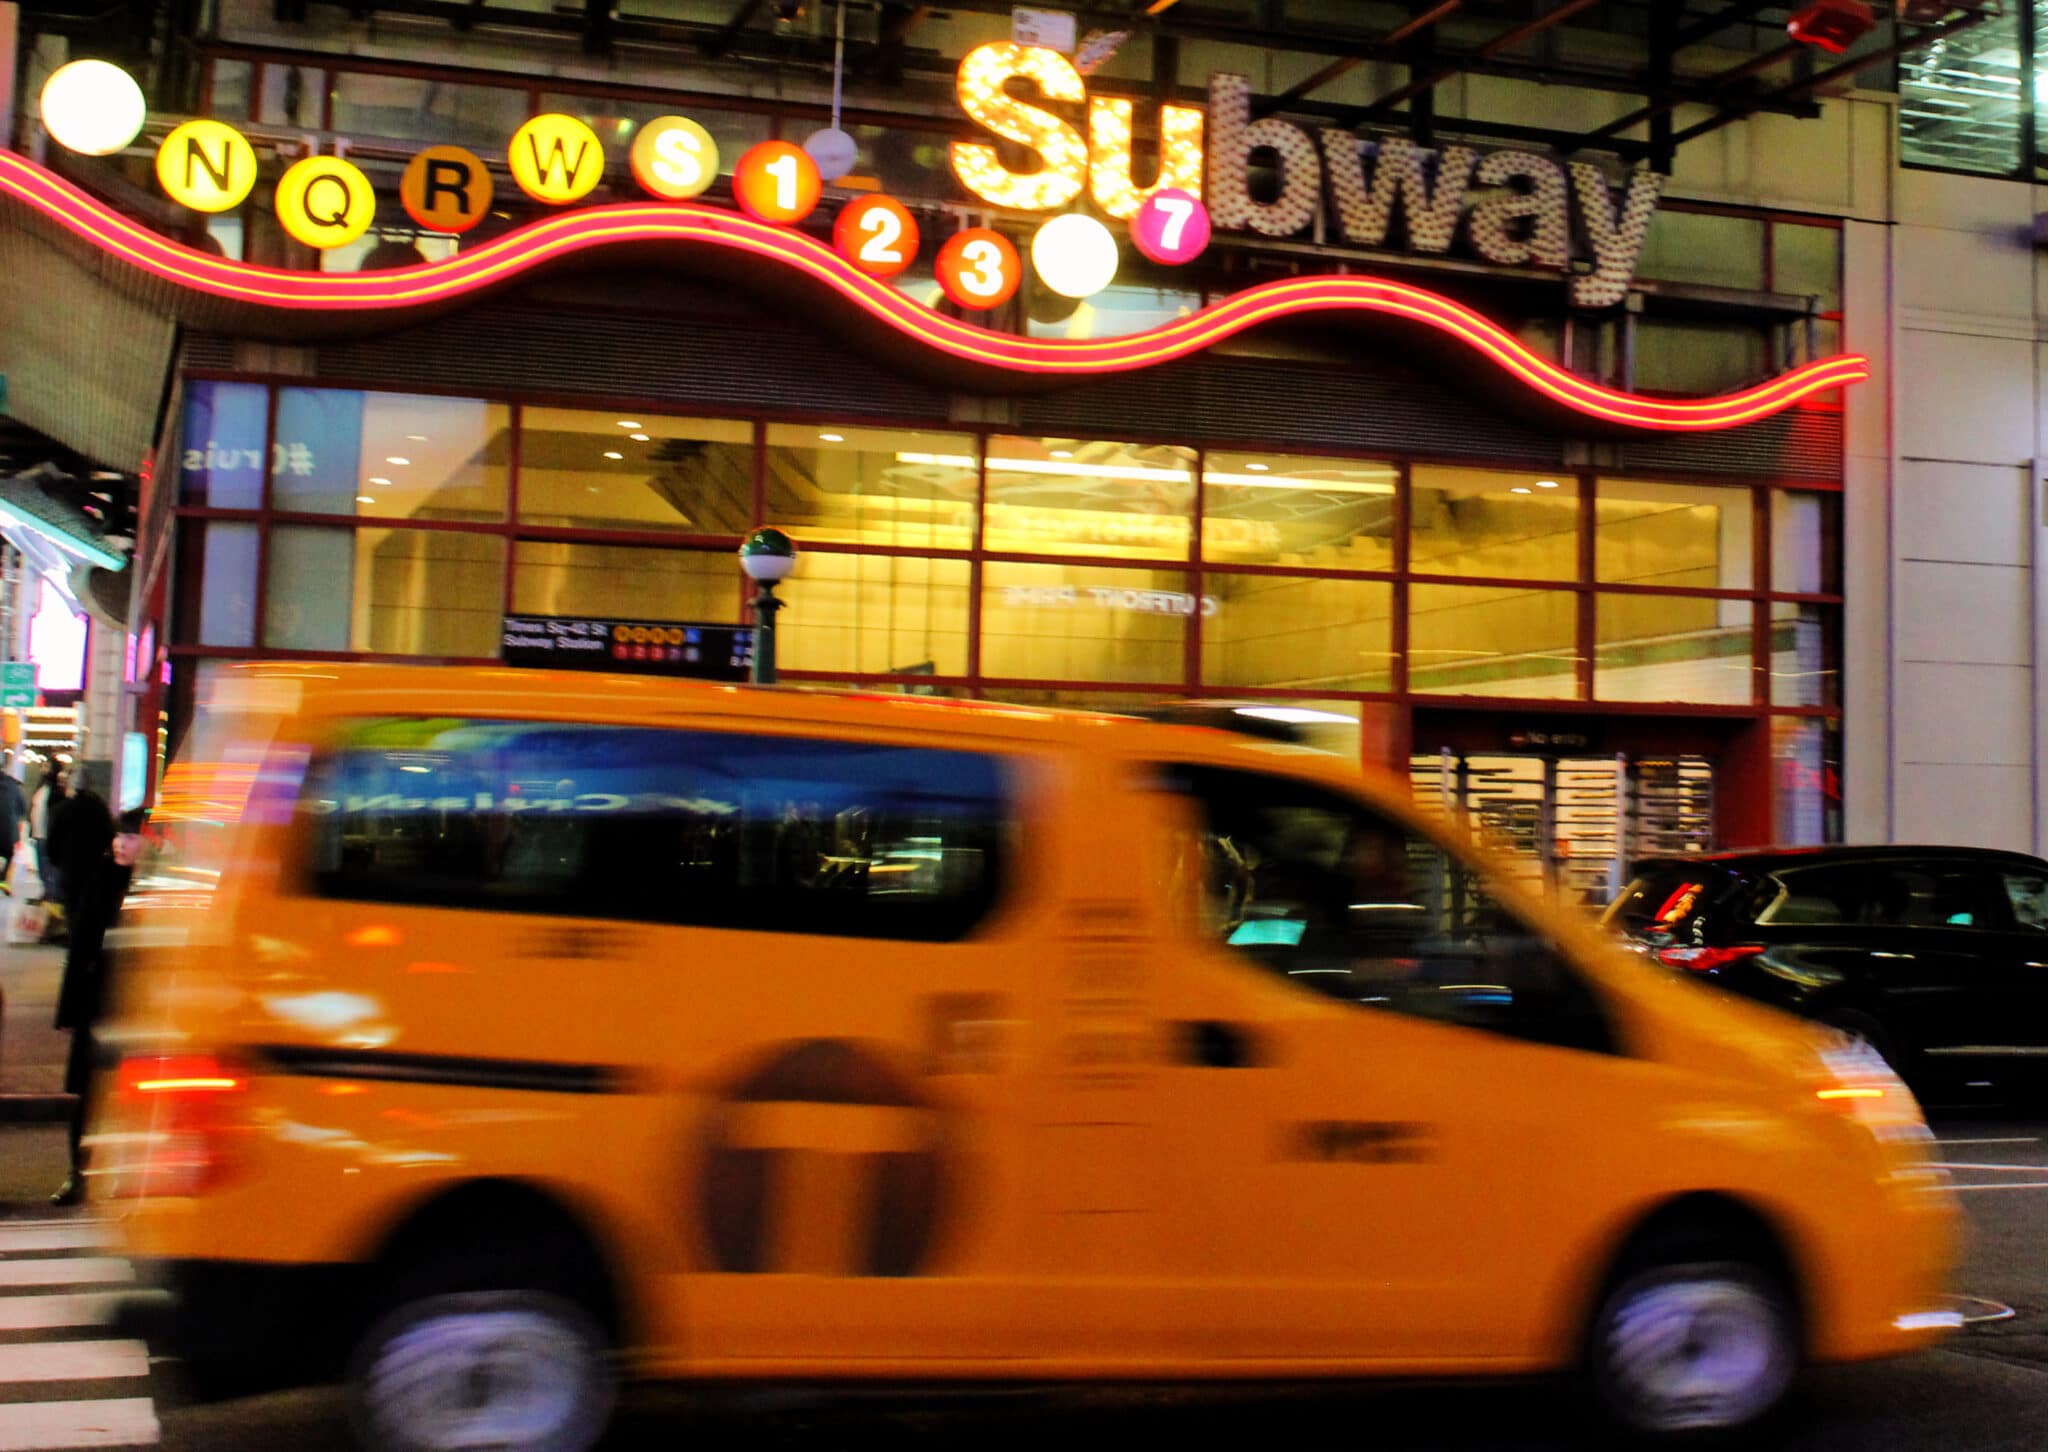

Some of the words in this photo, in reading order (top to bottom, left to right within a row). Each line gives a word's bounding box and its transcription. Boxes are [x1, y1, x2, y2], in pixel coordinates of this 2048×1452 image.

[186, 137, 230, 192] N
[303, 174, 350, 229] Q
[424, 159, 471, 215] R
[528, 132, 588, 190] W
[650, 127, 702, 187] S
[765, 154, 798, 211] 1
[859, 207, 902, 264] 2
[959, 239, 1004, 296] 3
[1153, 197, 1193, 250] 7
[951, 40, 1663, 308] Subway
